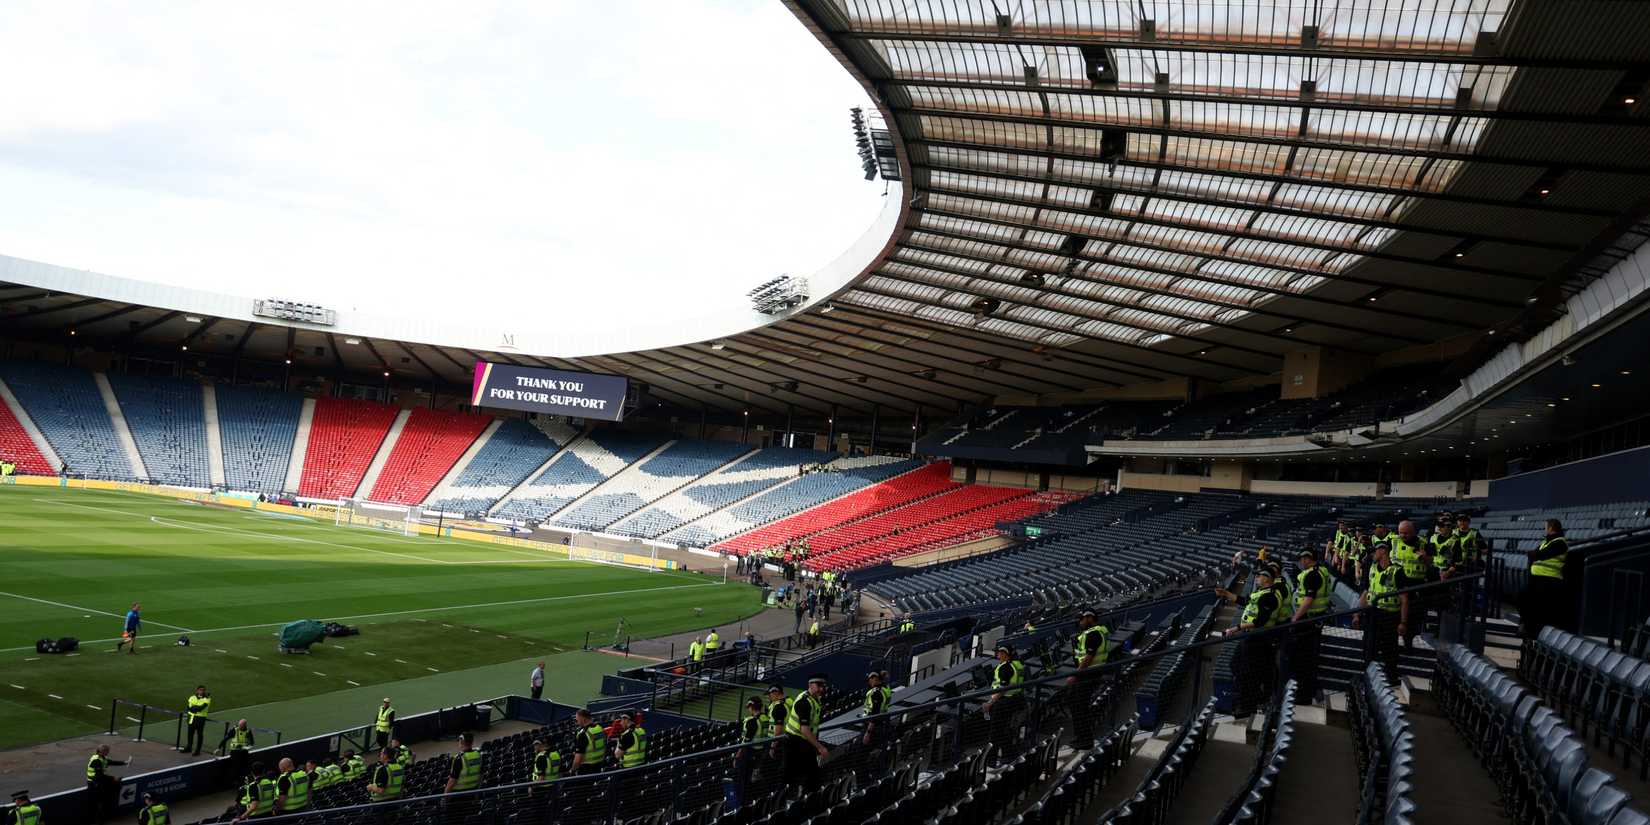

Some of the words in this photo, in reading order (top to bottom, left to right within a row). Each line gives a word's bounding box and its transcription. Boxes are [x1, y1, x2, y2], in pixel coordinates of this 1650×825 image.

[516, 376, 557, 389] THANK
[558, 381, 583, 392] YOU
[490, 388, 514, 400] FOR
[516, 391, 549, 404] YOUR
[550, 394, 607, 410] SUPPORT
